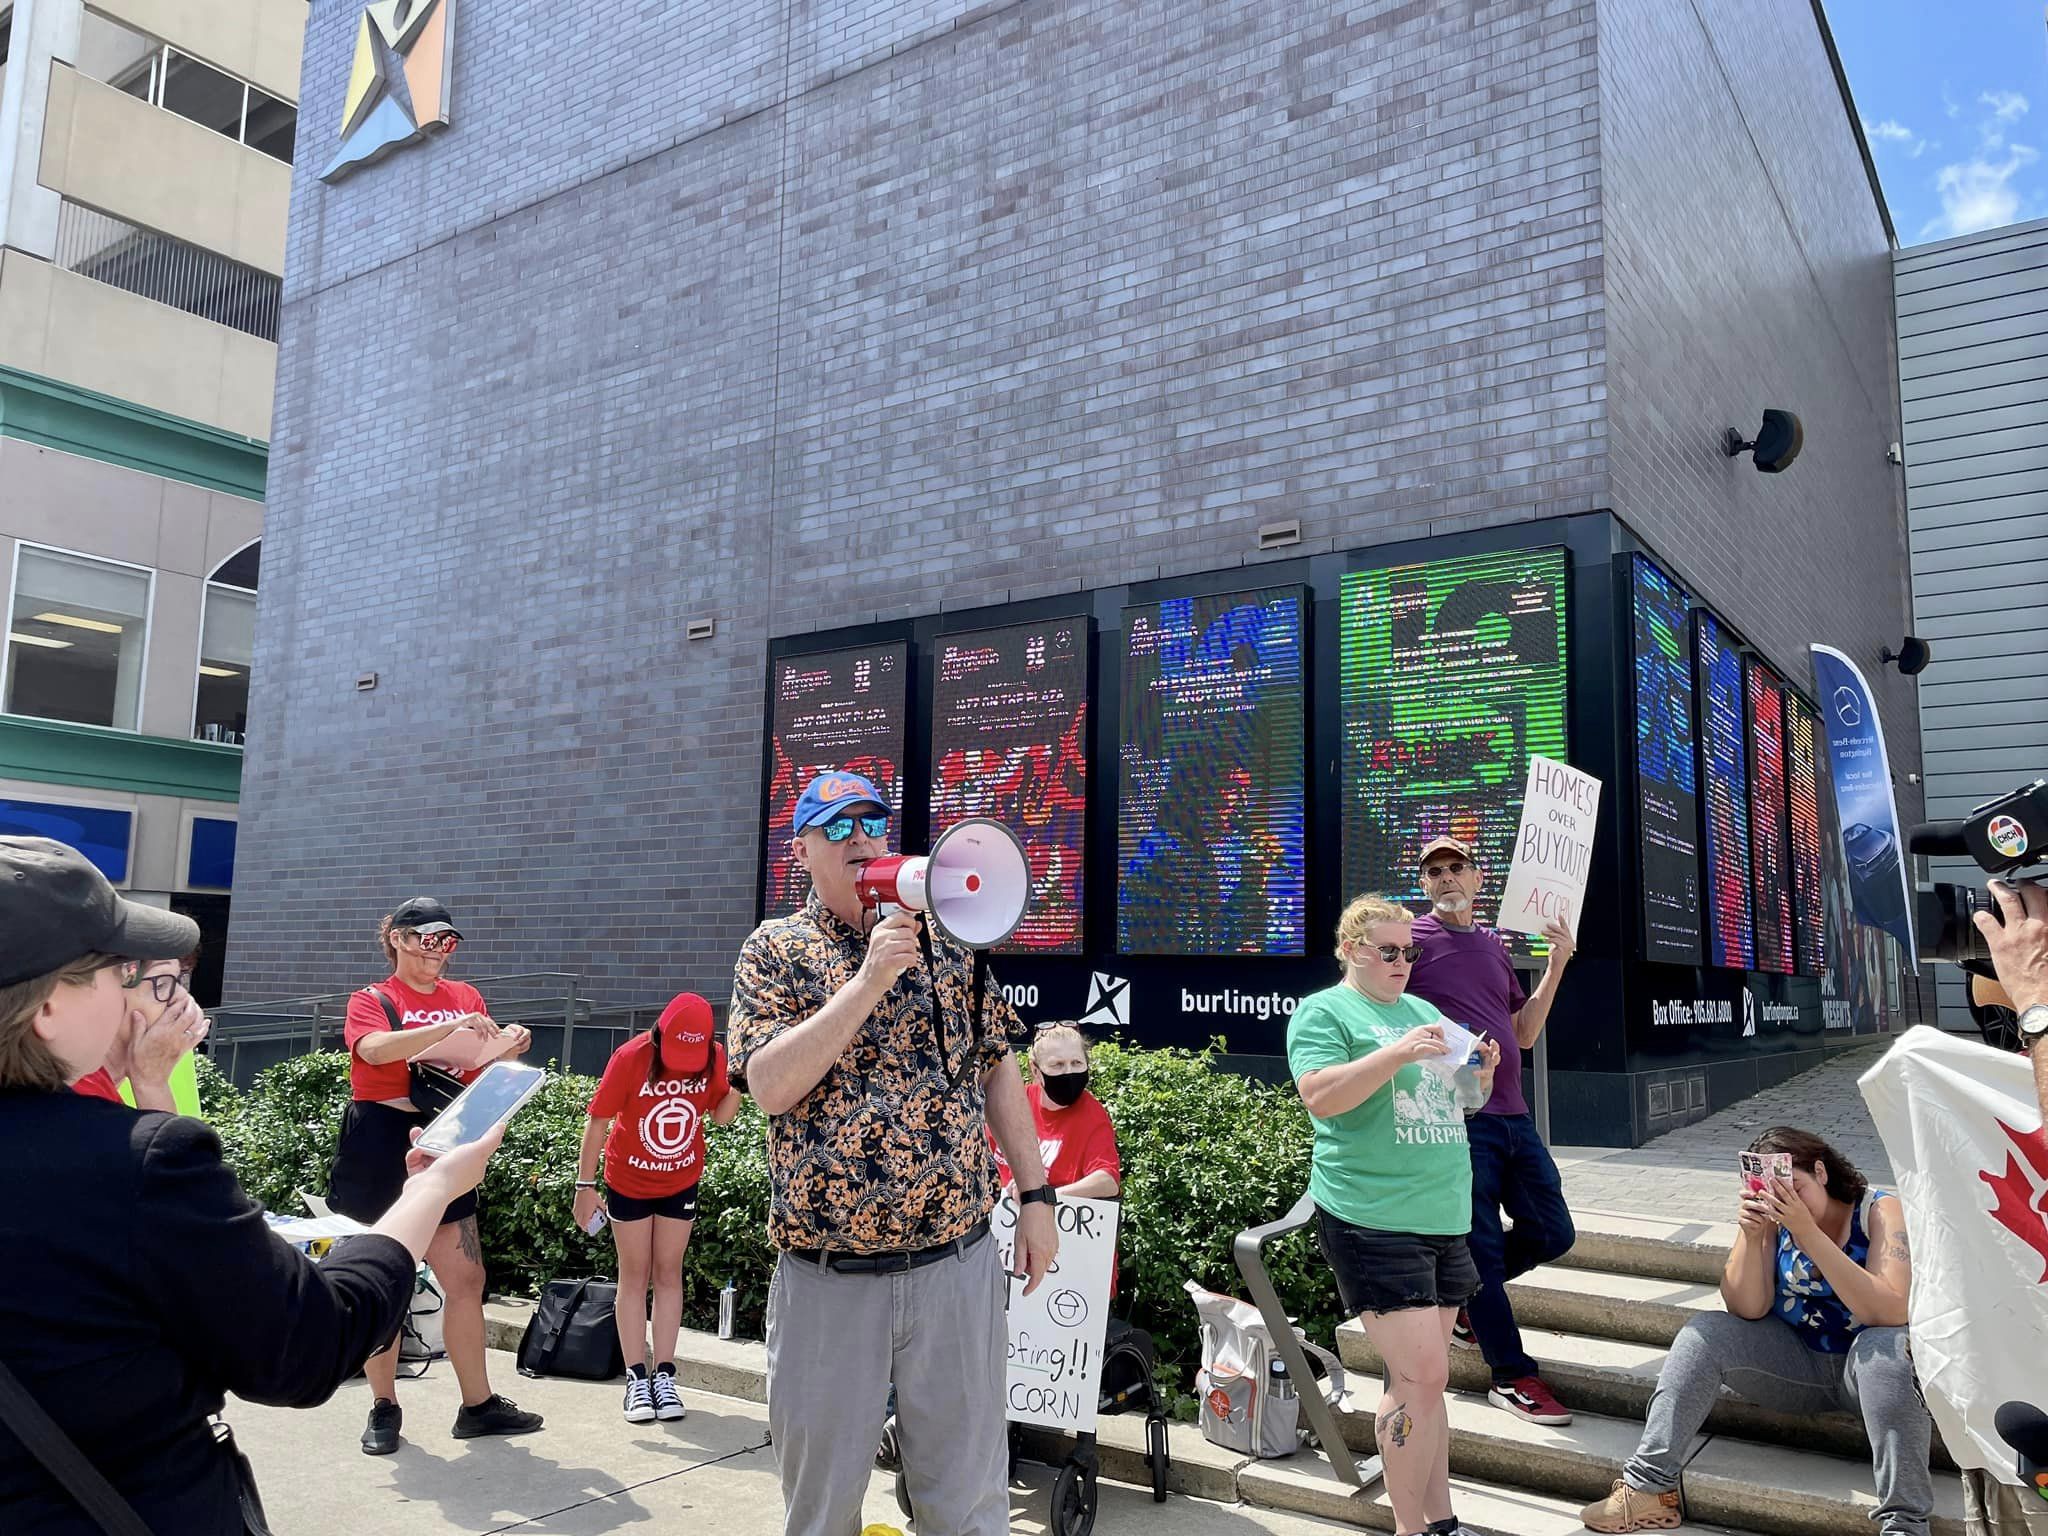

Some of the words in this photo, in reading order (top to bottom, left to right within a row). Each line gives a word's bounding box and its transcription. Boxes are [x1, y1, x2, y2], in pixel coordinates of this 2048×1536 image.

[1535, 762, 1595, 817] HOMES
[1548, 808, 1577, 832] OVER
[1997, 829, 2018, 844] CHCH
[1521, 822, 1591, 887] BUYOUTS
[1181, 988, 1304, 1021] burlingto
[1652, 999, 1669, 1026] Box
[1668, 999, 1693, 1025] Office:
[675, 1032, 705, 1044] ACORN
[638, 1077, 708, 1097] ACORN
[628, 1150, 696, 1172] HAMILTON
[1006, 1383, 1079, 1419] CORN
